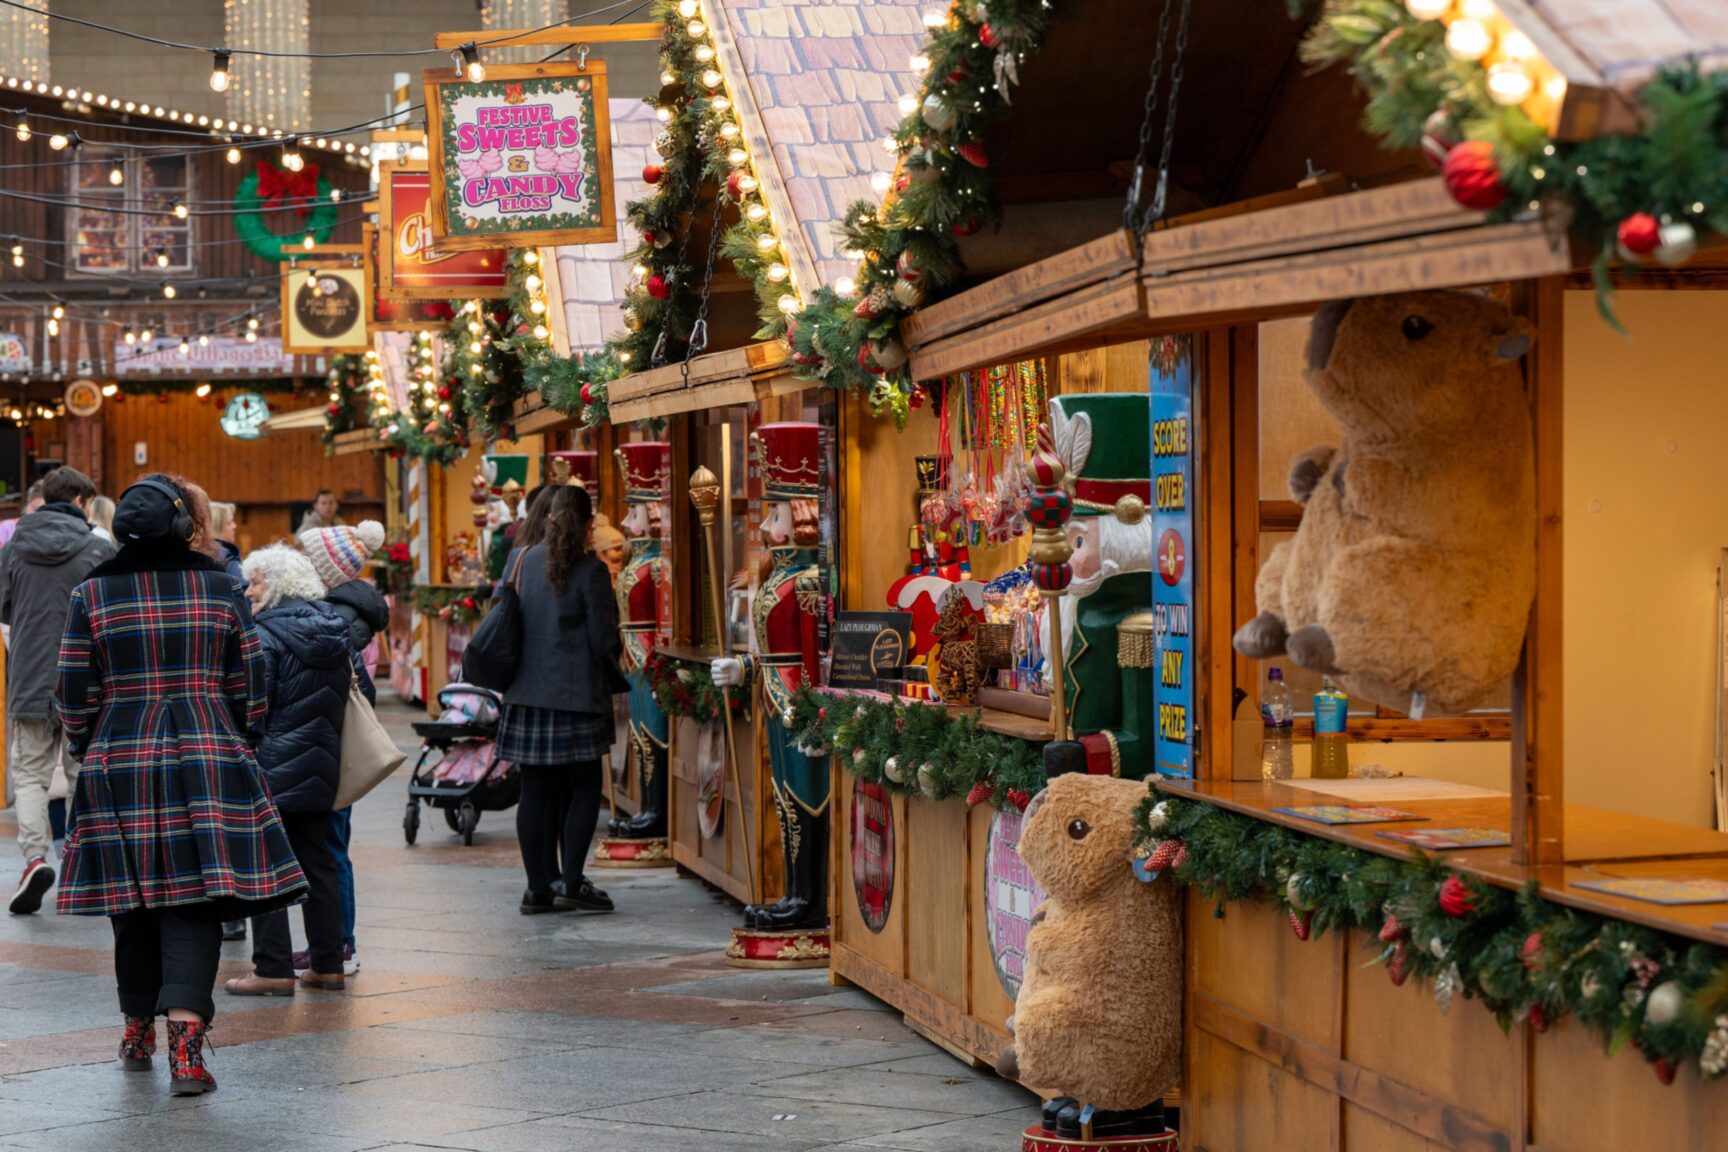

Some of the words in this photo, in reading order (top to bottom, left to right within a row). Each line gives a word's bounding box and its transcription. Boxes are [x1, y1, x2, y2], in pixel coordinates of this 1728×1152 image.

[478, 104, 553, 126] FESTIVE
[457, 117, 580, 152] SWEETS
[507, 155, 530, 173] &
[464, 172, 584, 207] CANDY
[499, 196, 552, 212] FLOSS
[1154, 418, 1187, 457] SCORE
[1156, 473, 1185, 511] OVER
[1155, 603, 1167, 637] TO
[1169, 602, 1189, 637] WIN
[1161, 650, 1184, 689] ANY
[1159, 702, 1187, 744] PRIZE
